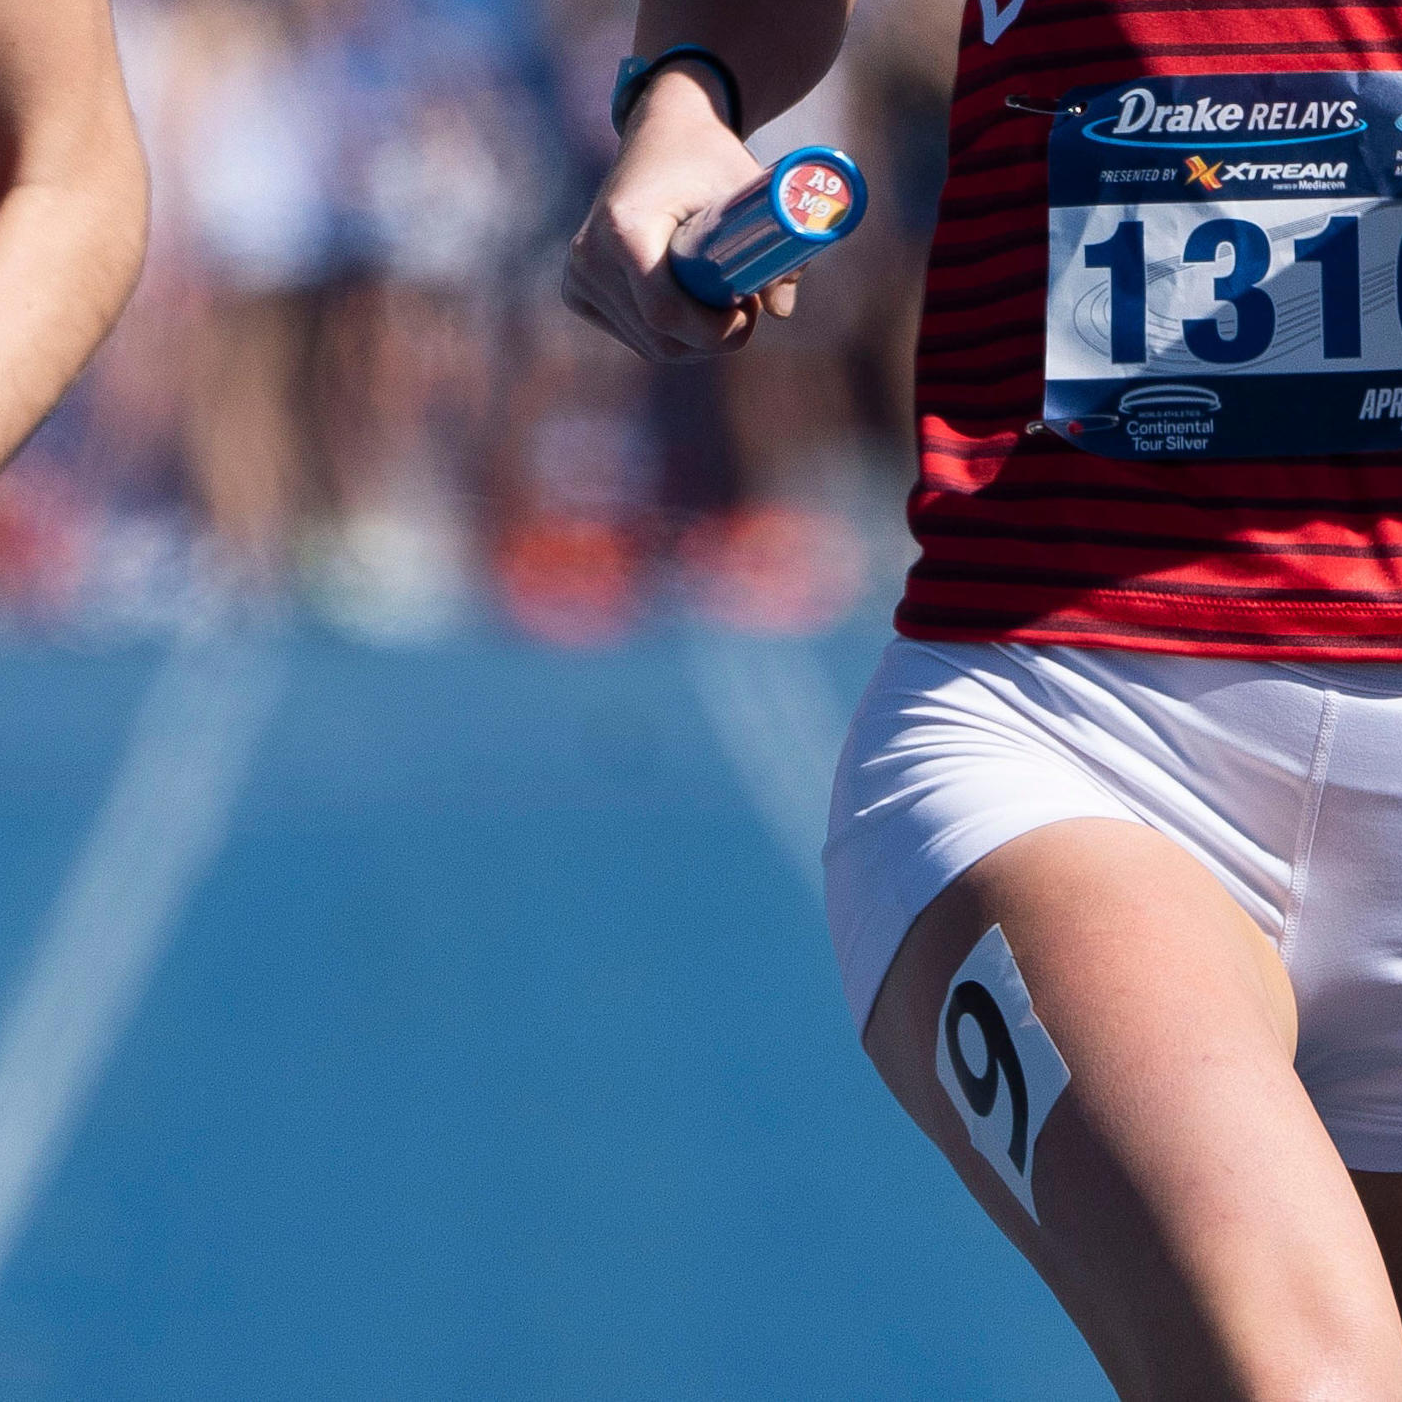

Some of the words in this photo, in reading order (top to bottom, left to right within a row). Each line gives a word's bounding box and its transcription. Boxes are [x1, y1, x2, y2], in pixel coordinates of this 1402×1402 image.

[1112, 88, 1244, 134] Drake
[806, 167, 842, 196] A9
[1099, 169, 1159, 183] PRESENTED
[1162, 168, 1178, 182] BY
[1221, 162, 1348, 181] XTREAM
[796, 191, 831, 218] M9
[1126, 419, 1214, 435] Continental
[1132, 437, 1164, 451] Tour
[1166, 436, 1209, 450] Silver
[944, 979, 1029, 1175] 9
